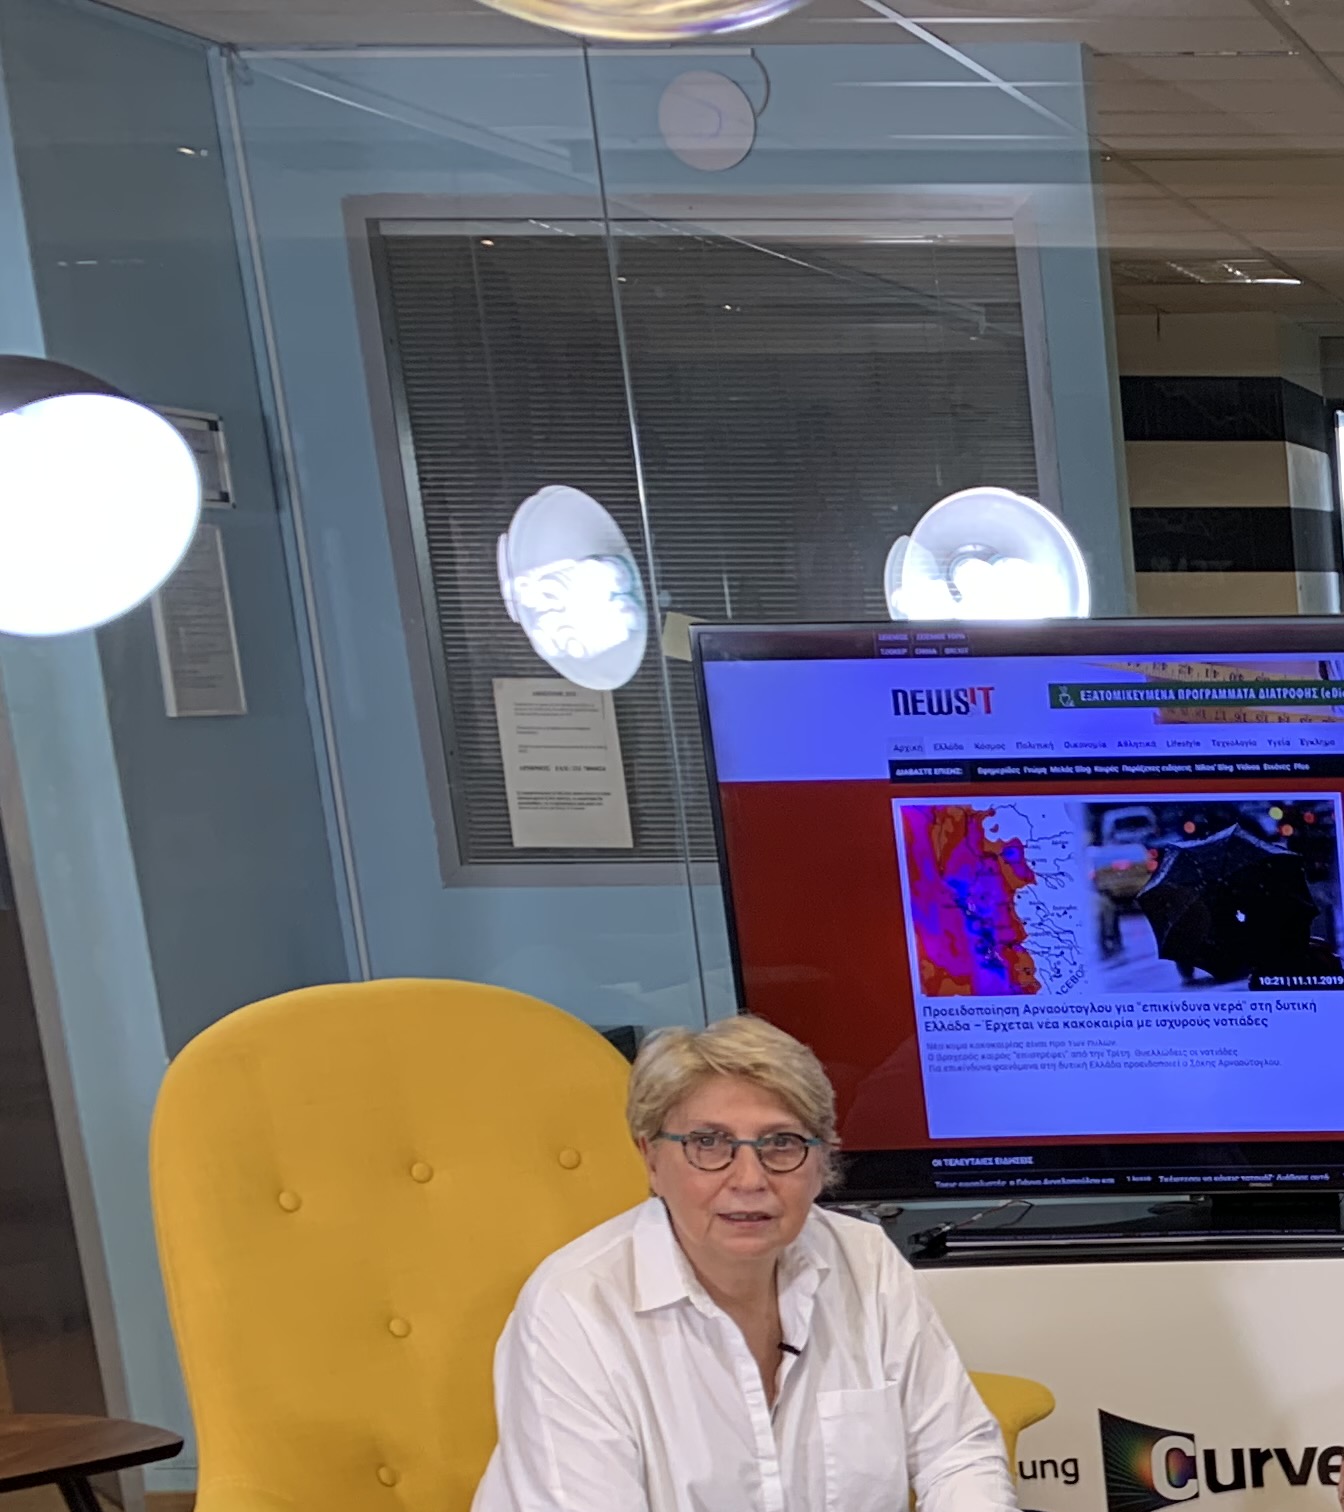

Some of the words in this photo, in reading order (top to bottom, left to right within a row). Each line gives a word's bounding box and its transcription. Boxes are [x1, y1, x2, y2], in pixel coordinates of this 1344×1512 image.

[1080, 689, 1175, 702] ΕΞΑΤΟΜΙΚΕΥΜΕΝΑ
[1177, 688, 1256, 701] ΠΡΟΓΡΑΜΜΑΤΑ
[1258, 686, 1319, 700] ΔΙΑΤΡΟΦΗΣ
[1258, 976, 1285, 986] 10:21
[1292, 975, 1344, 986] 11.11.2019
[923, 1004, 1019, 1018] Προειδοποίηση
[1022, 1003, 1112, 1017] Αρναούτογλου
[1115, 1003, 1135, 1016] για
[1250, 1002, 1273, 1013] στη
[1275, 999, 1317, 1013] δυτική
[924, 1020, 970, 1032] Ελλάδα
[982, 1018, 1035, 1033] Έρχεται
[1037, 1018, 1060, 1030] νέα
[1062, 1017, 1133, 1030] κακοκαιρία
[1136, 1017, 1152, 1030] με
[1155, 1015, 1211, 1030] ισχυρούς
[1213, 1014, 1269, 1028] νοτιάδες
[1018, 1457, 1080, 1485] ung
